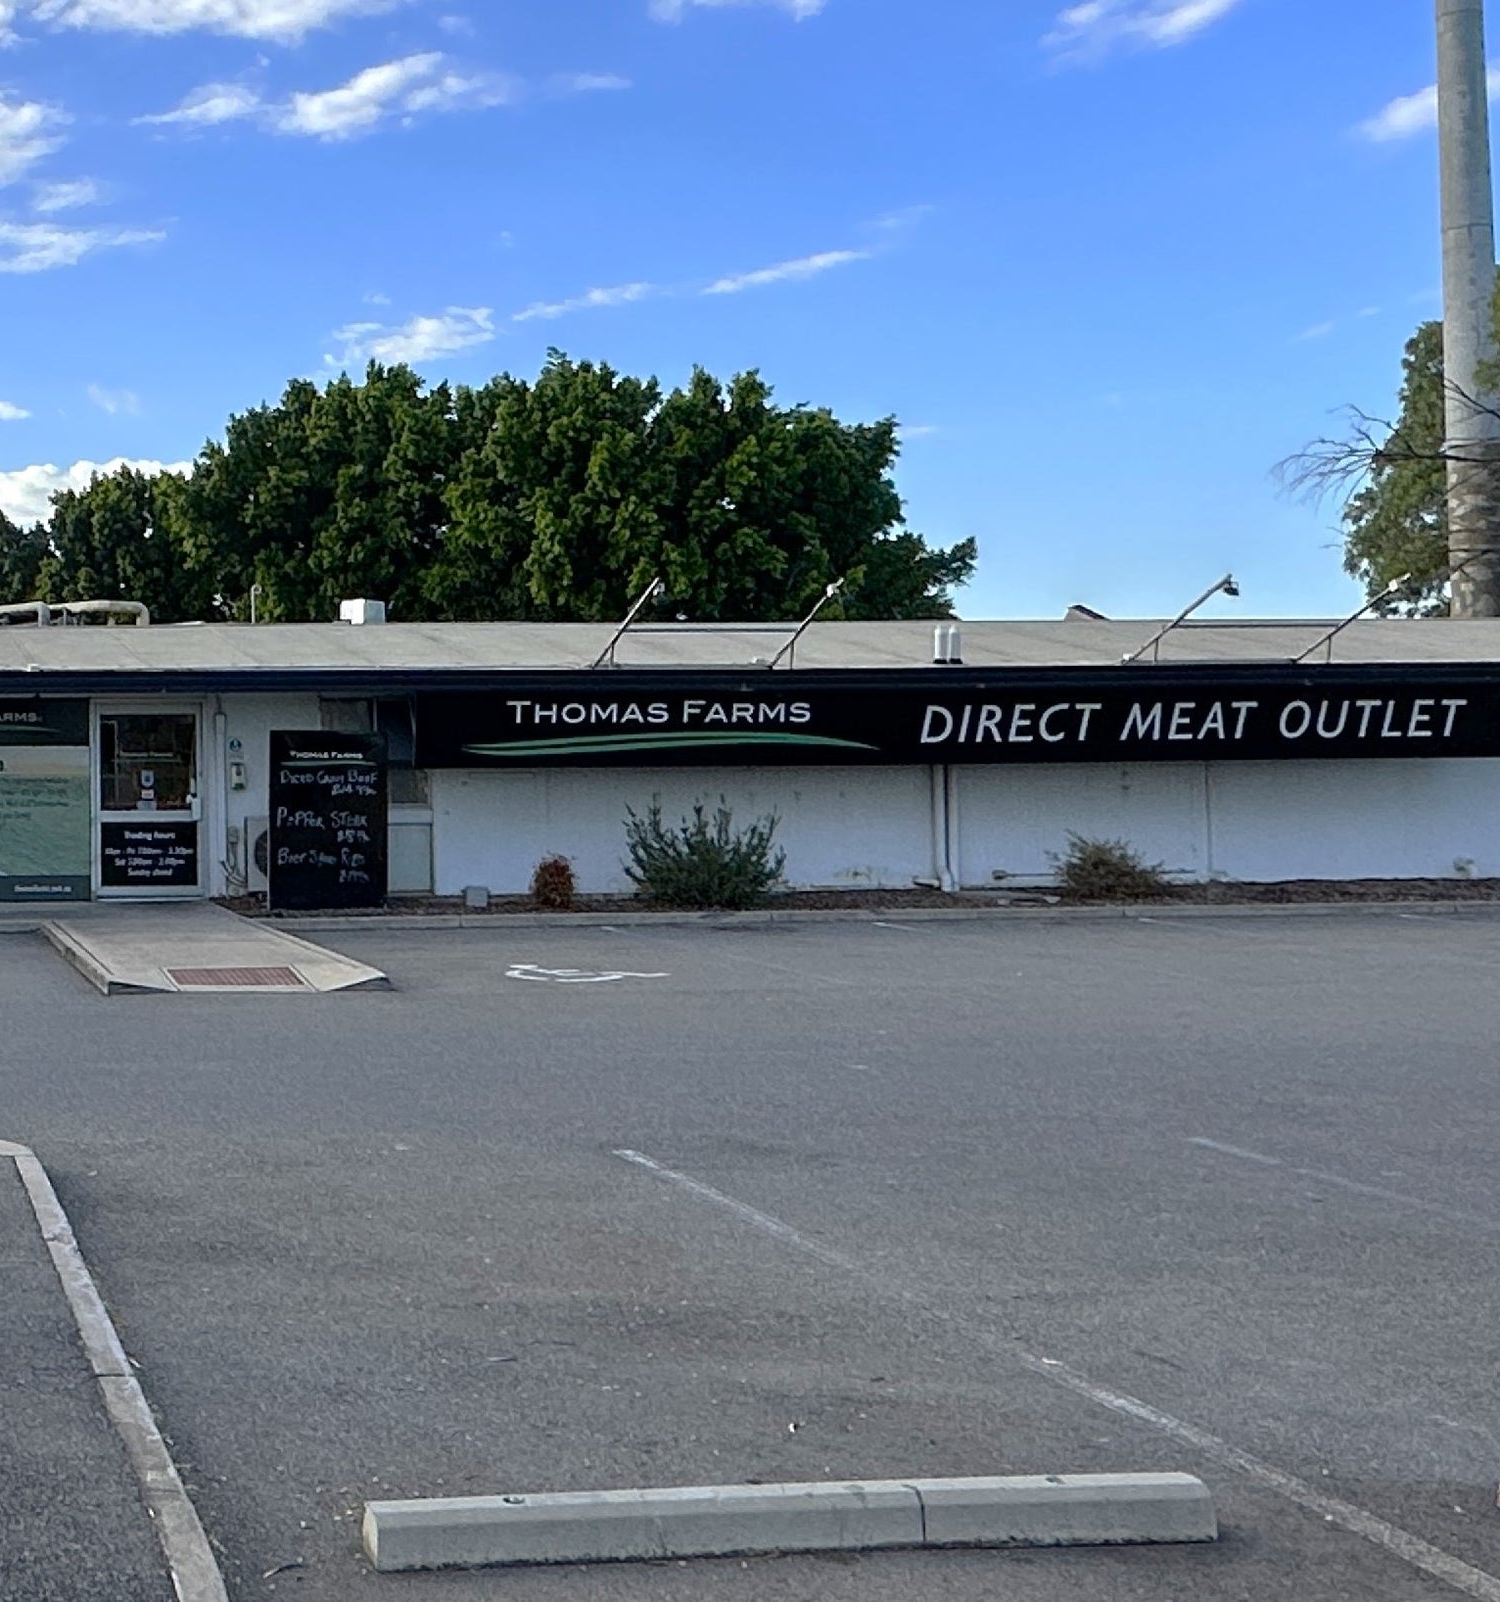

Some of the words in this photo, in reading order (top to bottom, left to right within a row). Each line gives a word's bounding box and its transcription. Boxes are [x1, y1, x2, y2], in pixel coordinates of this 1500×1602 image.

[506, 700, 669, 724] THOMAS
[682, 700, 811, 724] FARMS
[920, 703, 1102, 744] DIRECT
[1119, 702, 1259, 741] MEAT
[1278, 698, 1468, 739] OUTLET
[290, 750, 330, 759] THOMAS
[331, 751, 364, 759] FARMS
